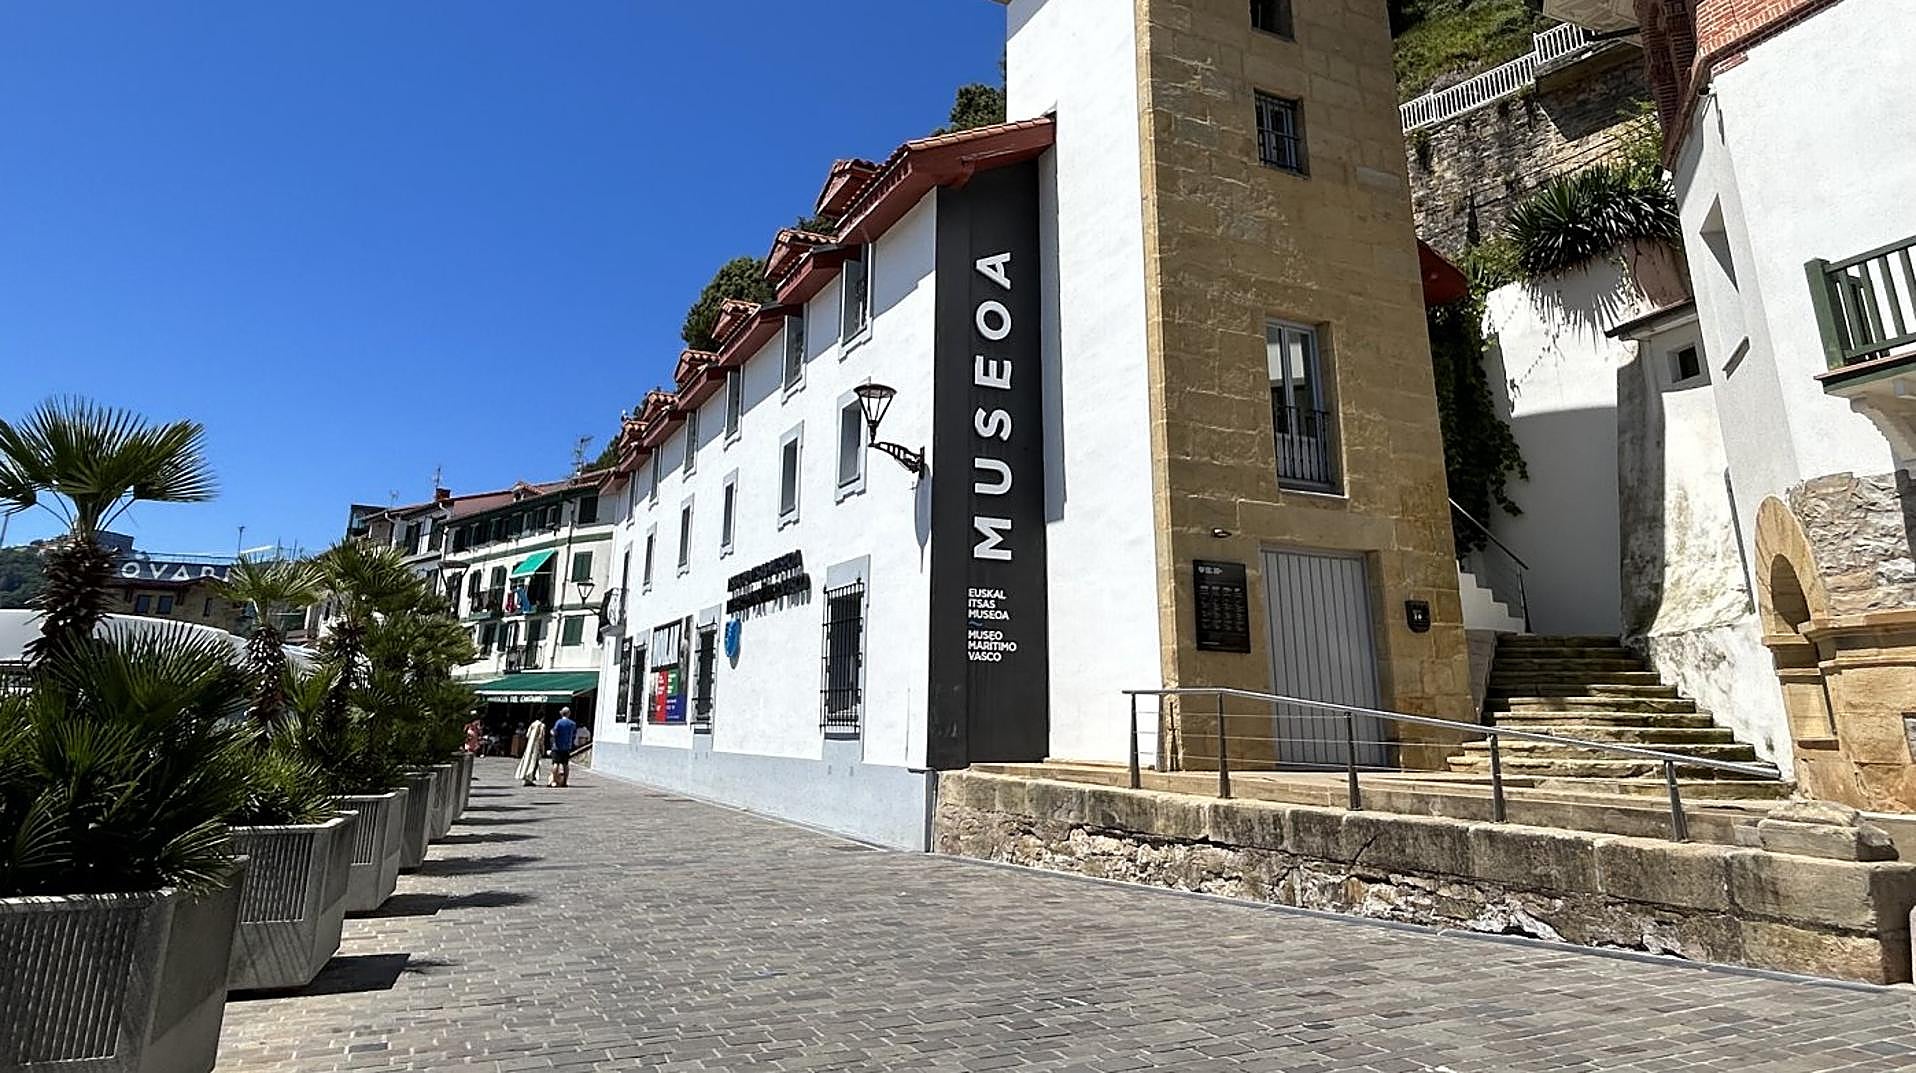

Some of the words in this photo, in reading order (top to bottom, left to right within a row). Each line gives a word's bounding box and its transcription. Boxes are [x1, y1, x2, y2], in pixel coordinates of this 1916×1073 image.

[973, 251, 1013, 561] MUSEOA
[968, 587, 1007, 599] EUSKAL
[968, 598, 996, 609] ITSAS
[968, 608, 1010, 620] MUSEOA
[968, 629, 1004, 641] MUSEO
[968, 640, 1018, 652] MARITIMO
[968, 651, 1002, 662] VASCO
